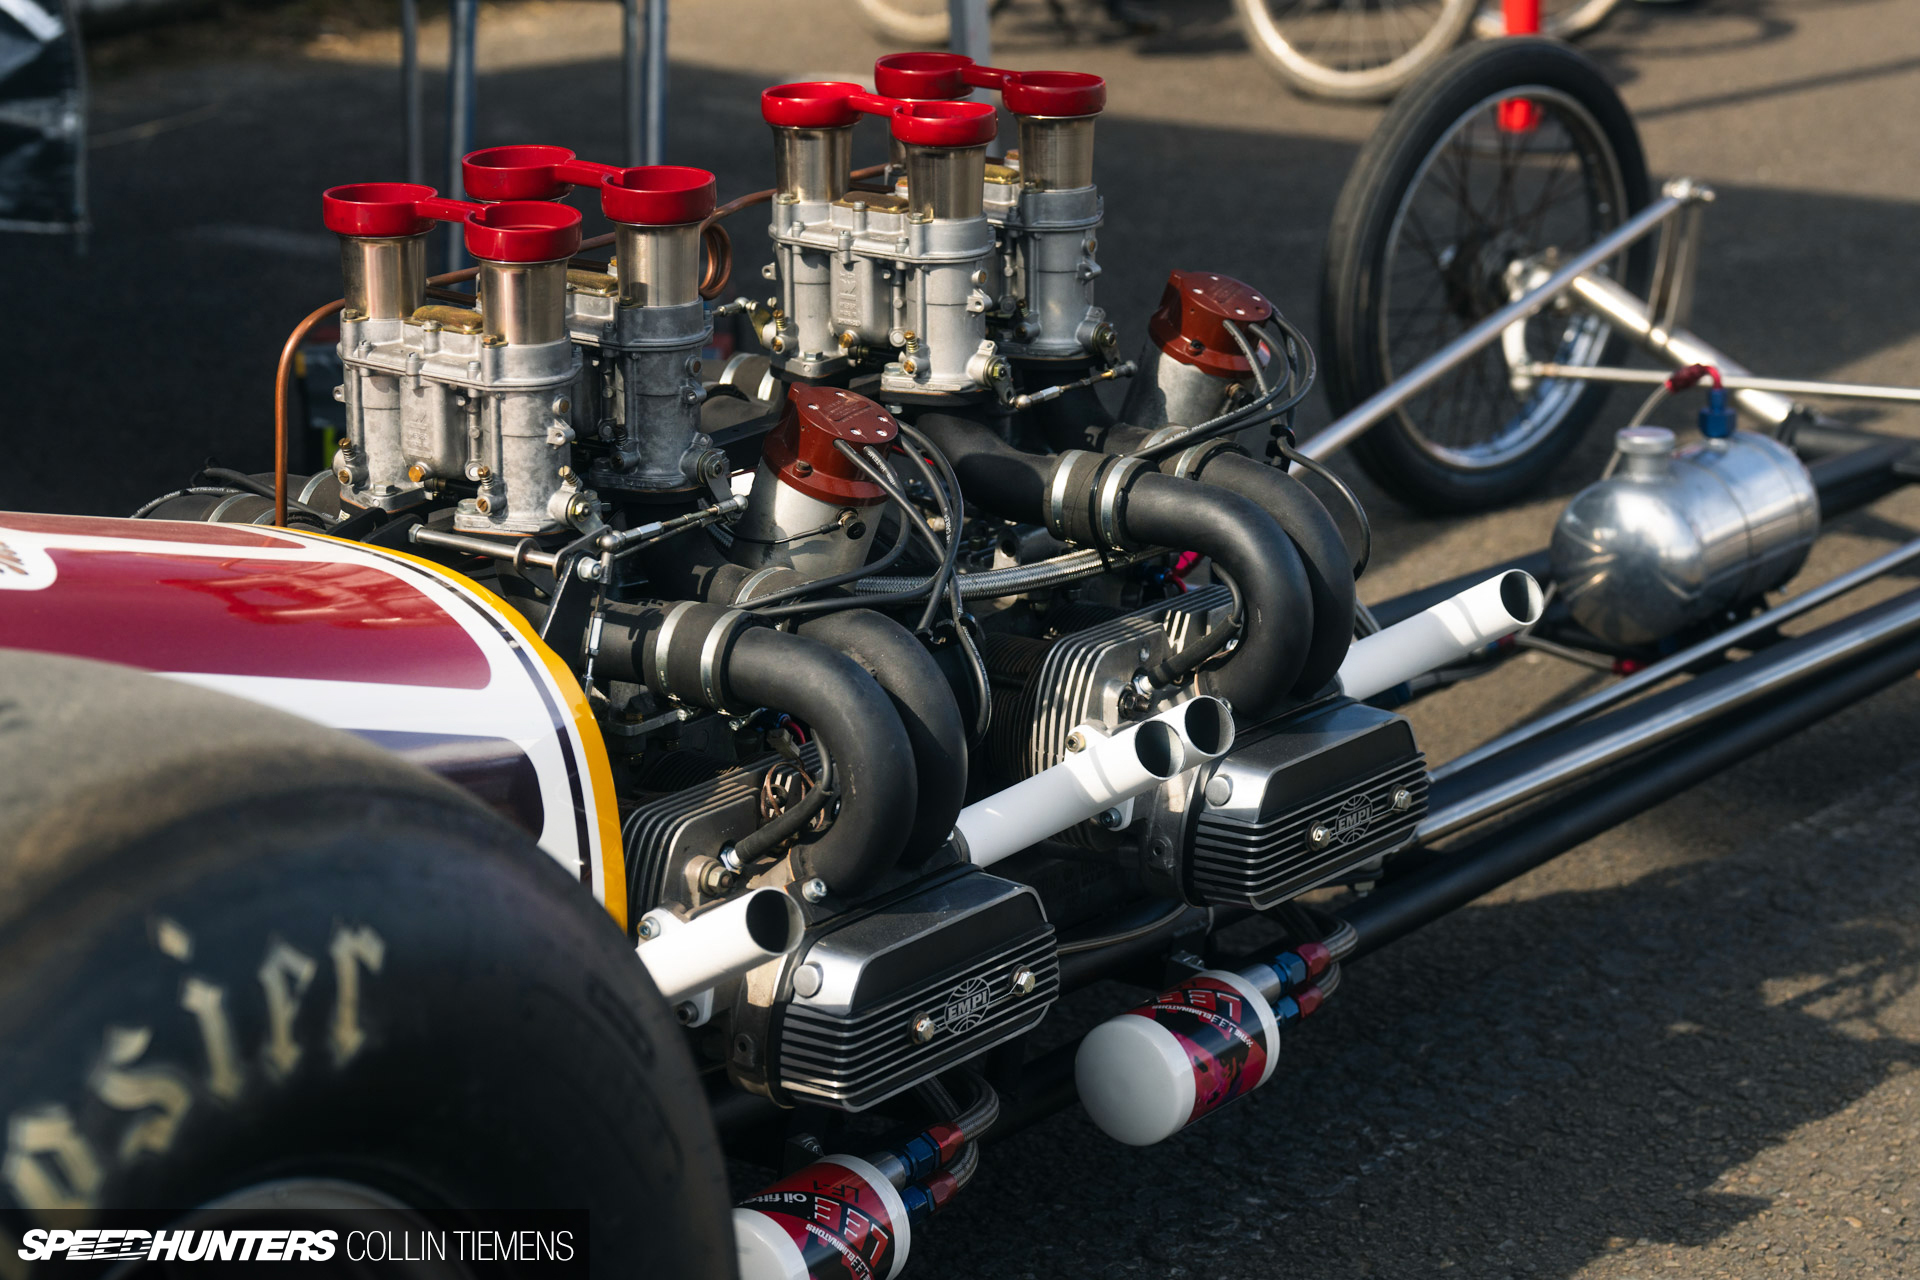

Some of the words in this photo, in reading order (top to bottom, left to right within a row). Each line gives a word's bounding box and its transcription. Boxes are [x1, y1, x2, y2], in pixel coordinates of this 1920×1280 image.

[1337, 806, 1371, 832] EMPI
[947, 990, 988, 1021] EMPI
[813, 1180, 859, 1204] LF-1
[805, 1223, 855, 1262] ELIMINATORS
[814, 1195, 889, 1269] LEE
